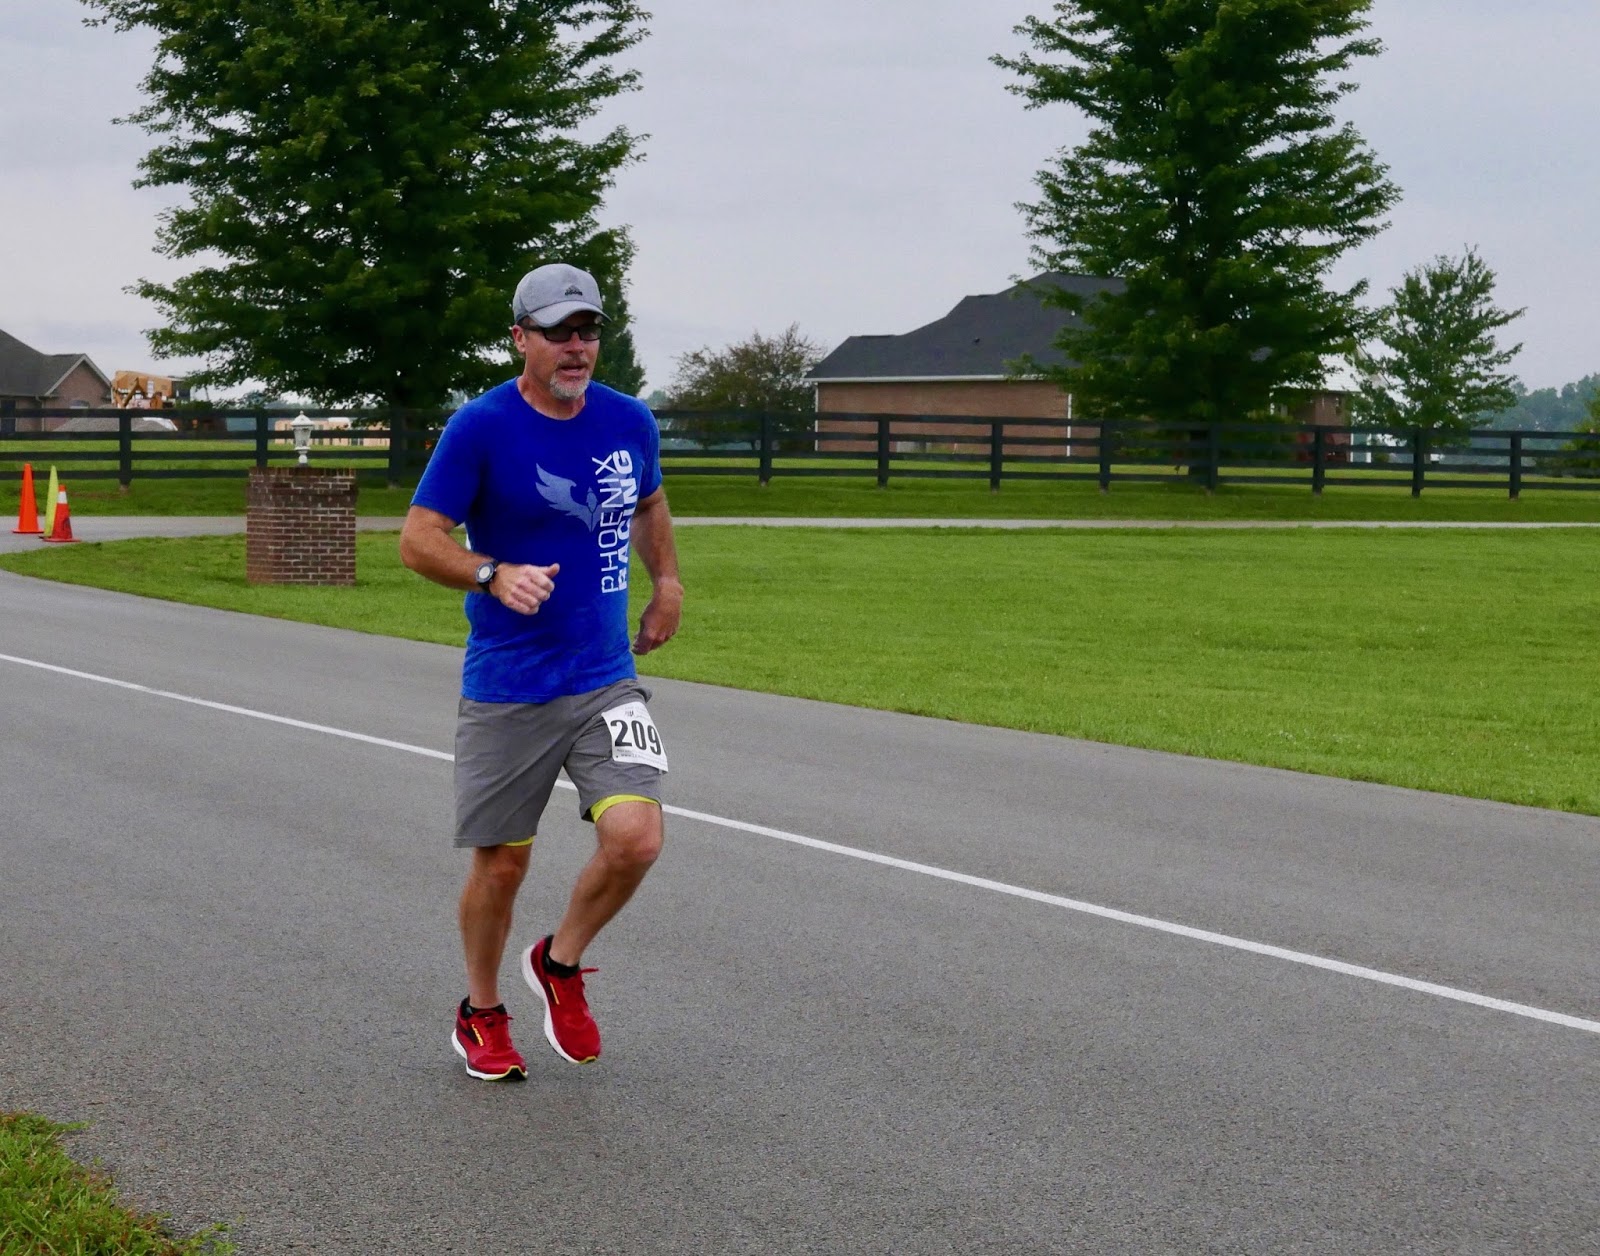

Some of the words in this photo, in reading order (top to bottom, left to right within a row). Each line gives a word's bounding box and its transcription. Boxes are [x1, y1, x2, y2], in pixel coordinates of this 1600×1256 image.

[592, 454, 625, 594] PHOENIX
[612, 449, 638, 591] RACING
[610, 719, 662, 756] 209
